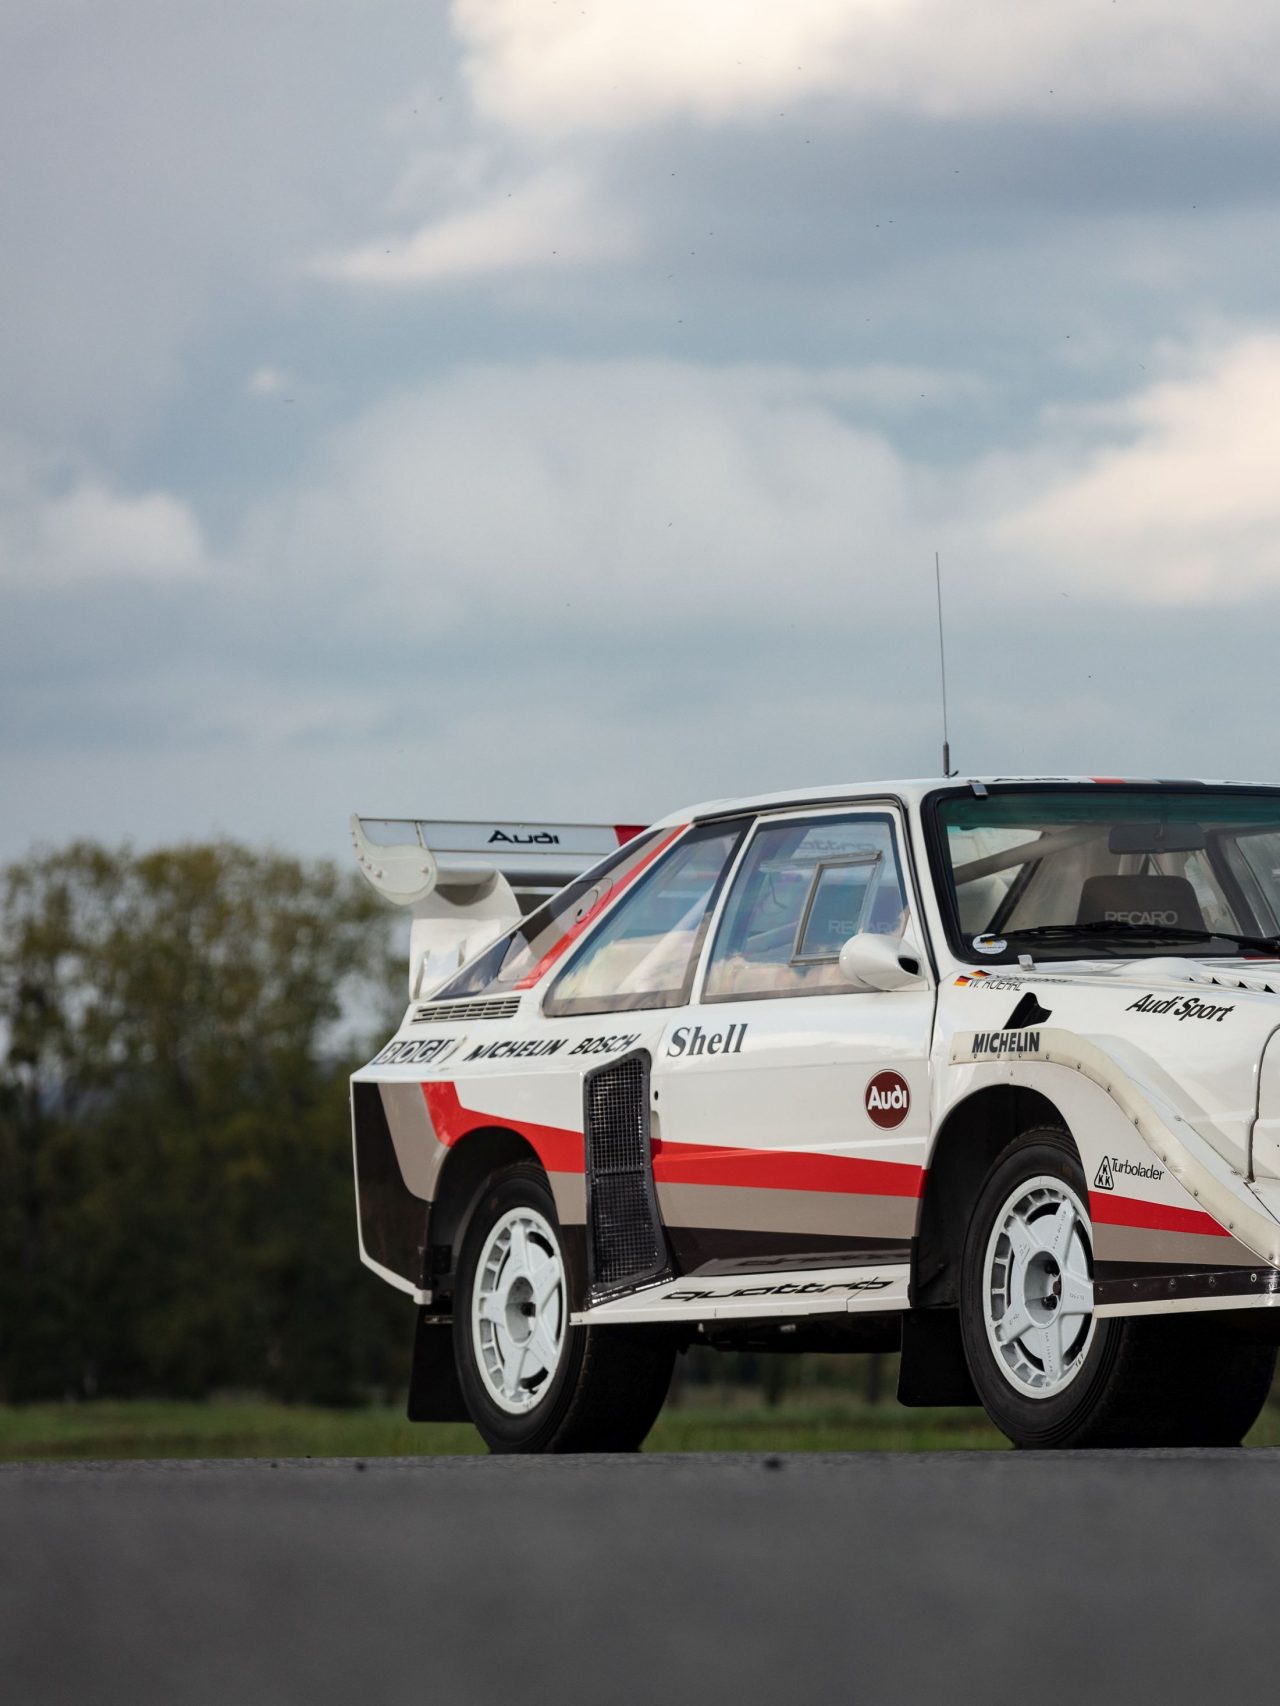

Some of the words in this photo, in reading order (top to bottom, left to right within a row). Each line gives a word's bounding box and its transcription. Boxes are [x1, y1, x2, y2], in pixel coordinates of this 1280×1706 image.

[487, 829, 560, 844] Audi
[1104, 911, 1178, 926] RECARO
[1173, 997, 1235, 1022] Sport
[462, 1038, 569, 1062] MICHELIN
[568, 1032, 642, 1056] BOSCH
[666, 1023, 748, 1057] Shell
[971, 1031, 1041, 1054] MICHELIN
[867, 1085, 908, 1110] Audi
[1111, 1157, 1165, 1181] Turbolader
[661, 1279, 894, 1302] quattro
